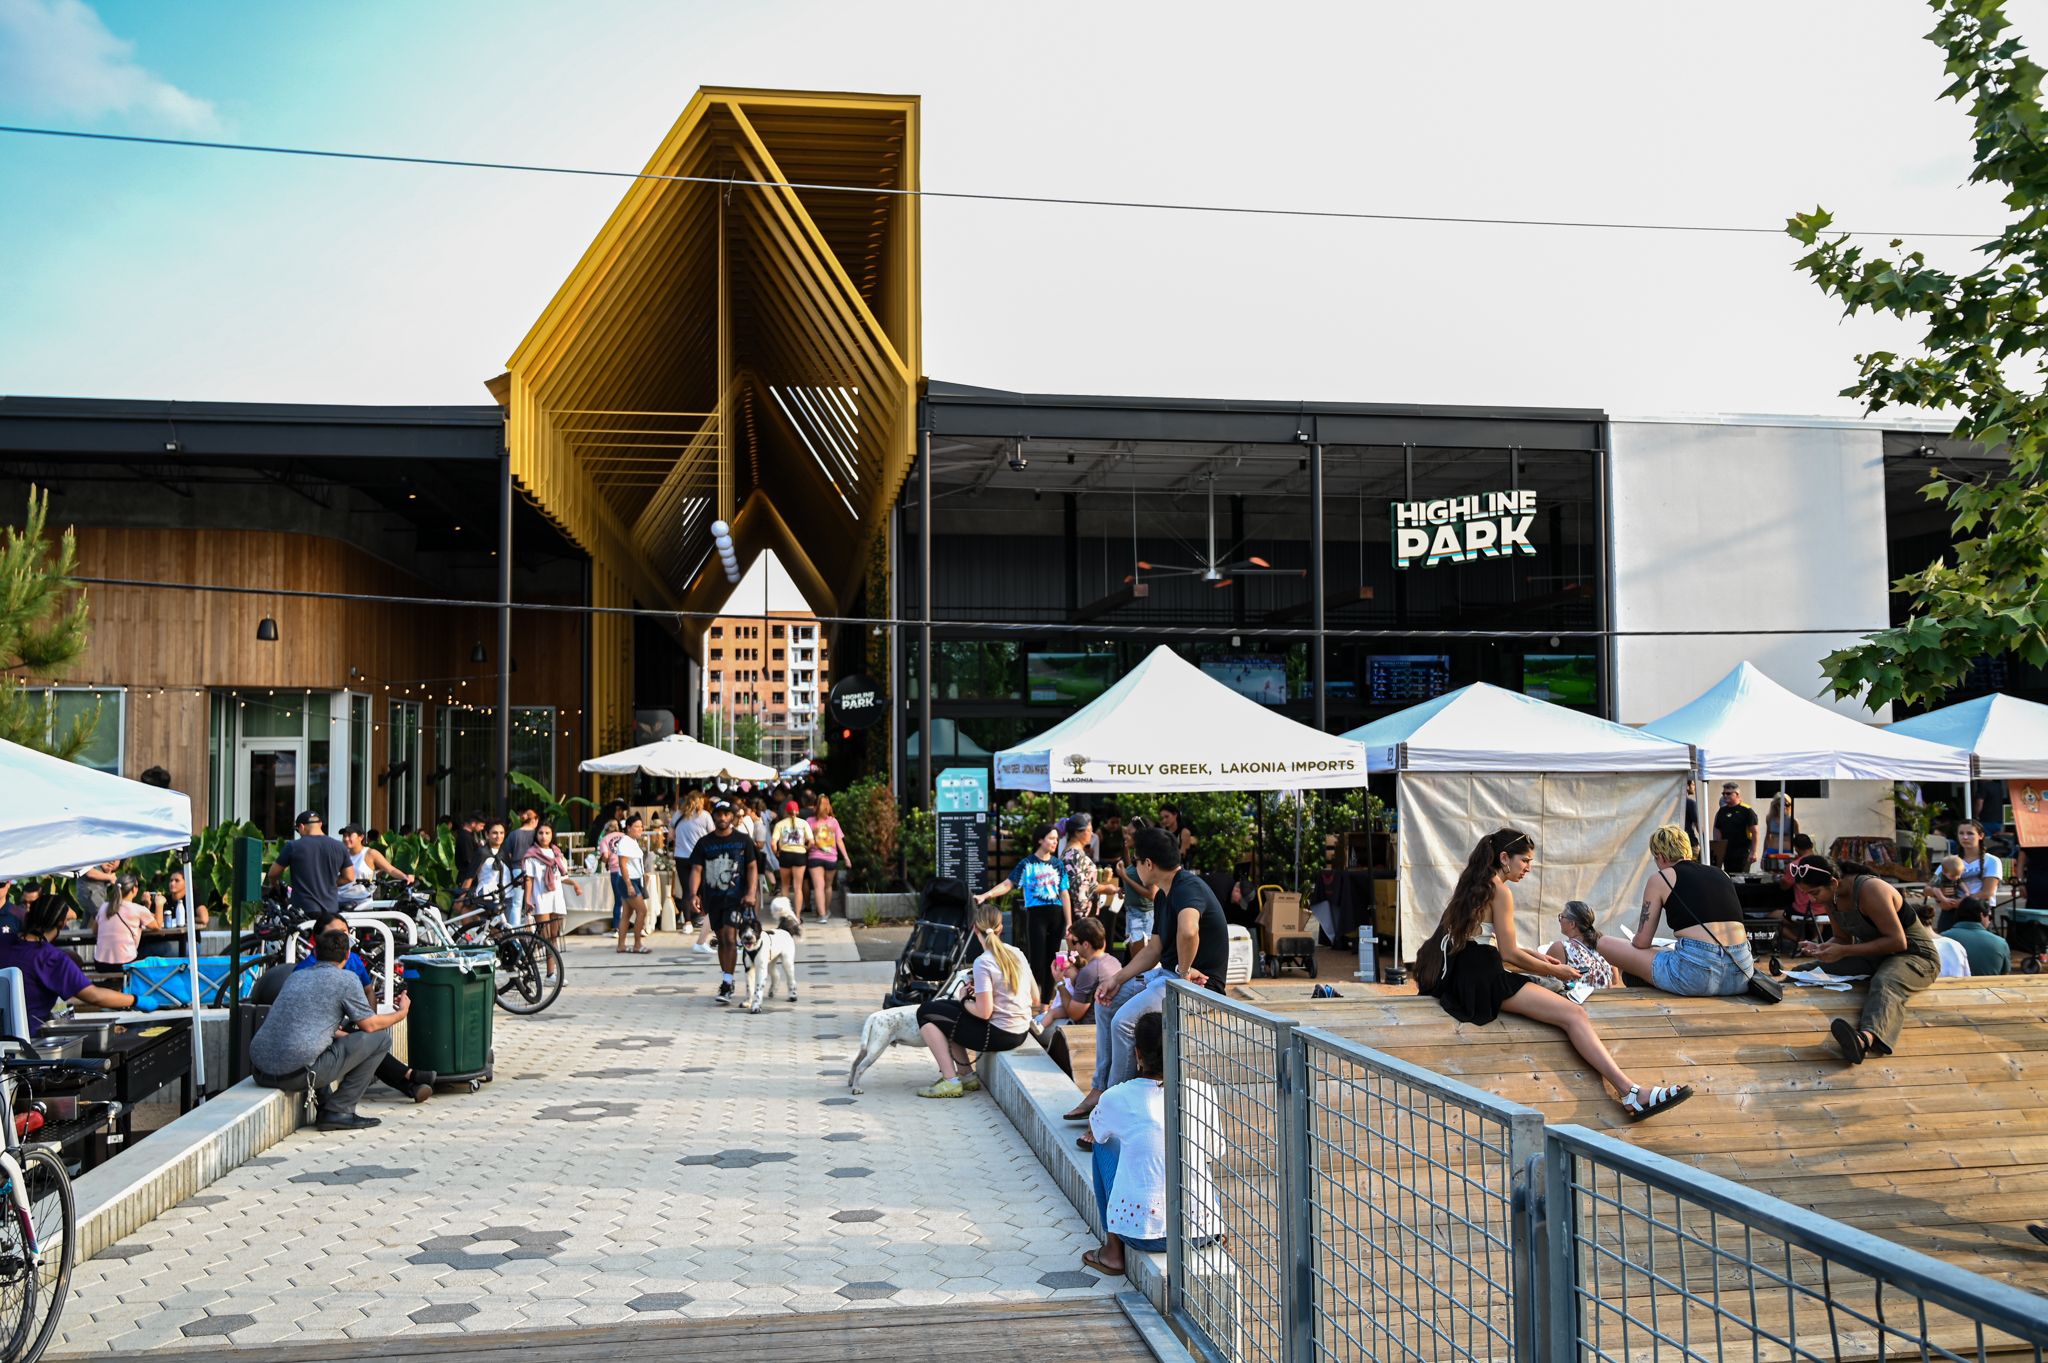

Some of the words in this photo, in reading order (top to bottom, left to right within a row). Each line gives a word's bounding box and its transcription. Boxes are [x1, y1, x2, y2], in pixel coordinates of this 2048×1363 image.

[1397, 490, 1537, 527] HIGHLINE
[1397, 516, 1538, 568] PARK
[841, 691, 875, 701] HIGHLINE
[841, 697, 875, 710] PARK
[1107, 763, 1154, 775] TRULY
[1159, 763, 1212, 776] GREEK,
[1221, 762, 1286, 774] LAKONIA
[1291, 760, 1355, 772] IMPORTS
